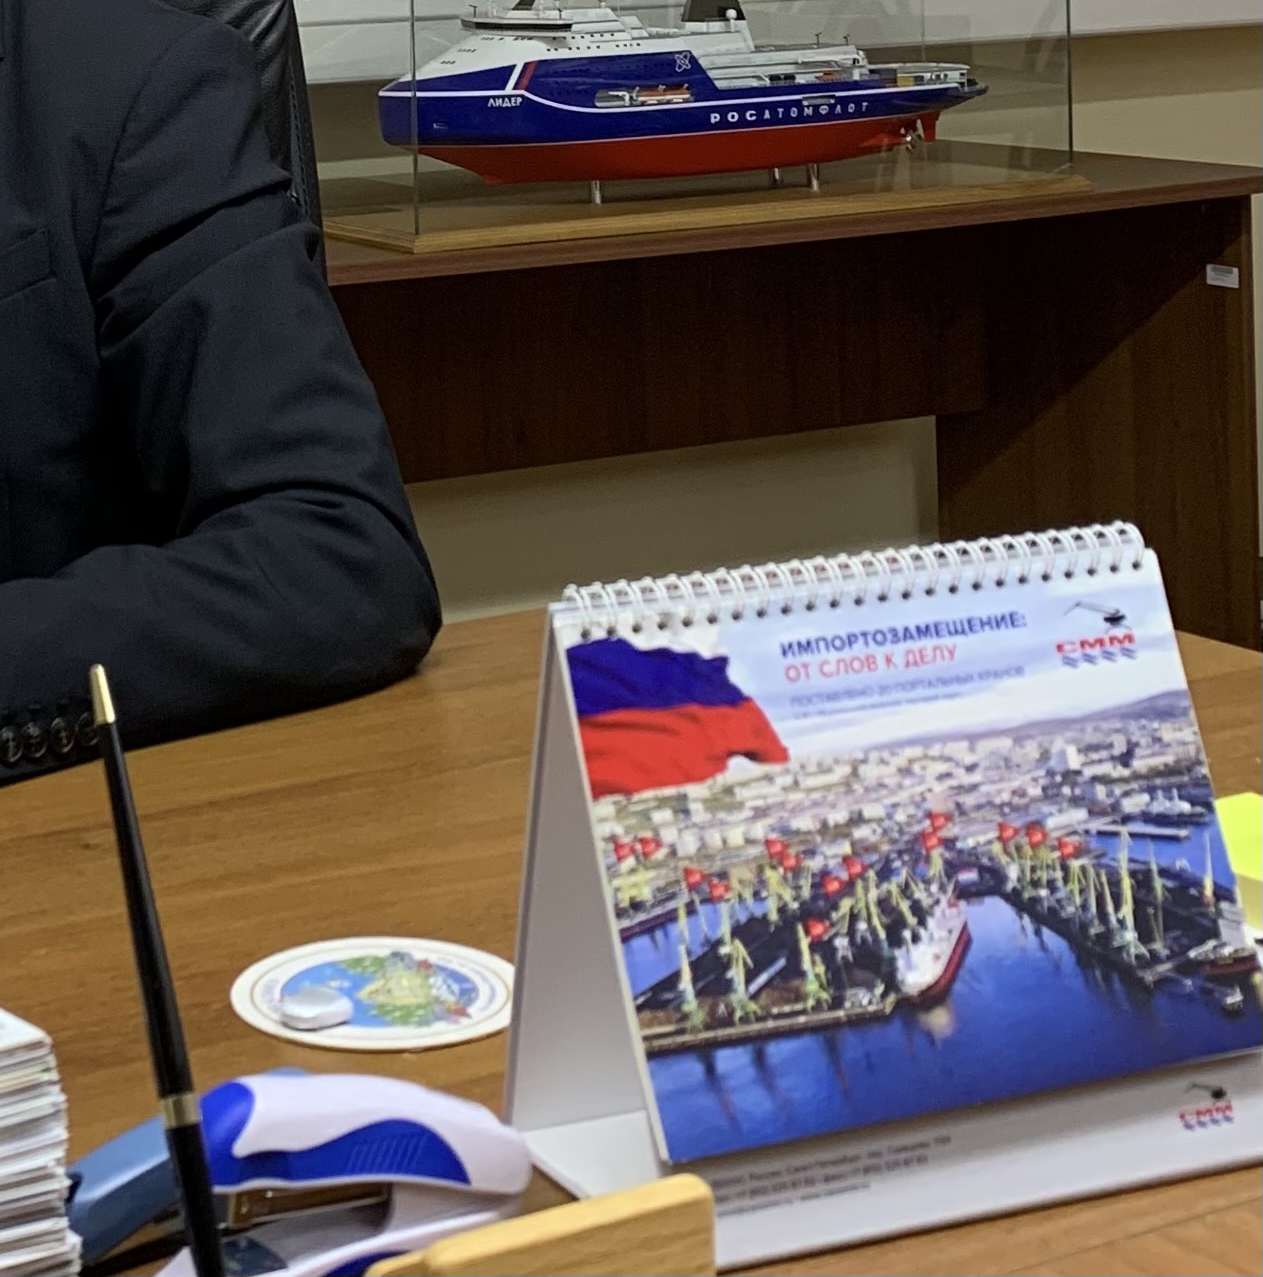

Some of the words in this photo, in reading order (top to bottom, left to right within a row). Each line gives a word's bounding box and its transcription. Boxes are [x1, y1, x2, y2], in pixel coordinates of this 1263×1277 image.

[487, 97, 523, 108] ЛИДЕР
[709, 102, 869, 124] РОСАТОМФЛОТ
[780, 610, 1027, 658] ИМПОРТОЗАМЕЩЕНИЕ:
[1056, 633, 1135, 654] СММ
[784, 662, 812, 684] ОТ
[819, 652, 879, 679] СЛОВ
[885, 652, 898, 670] К
[903, 643, 957, 671] ДЕЛУ
